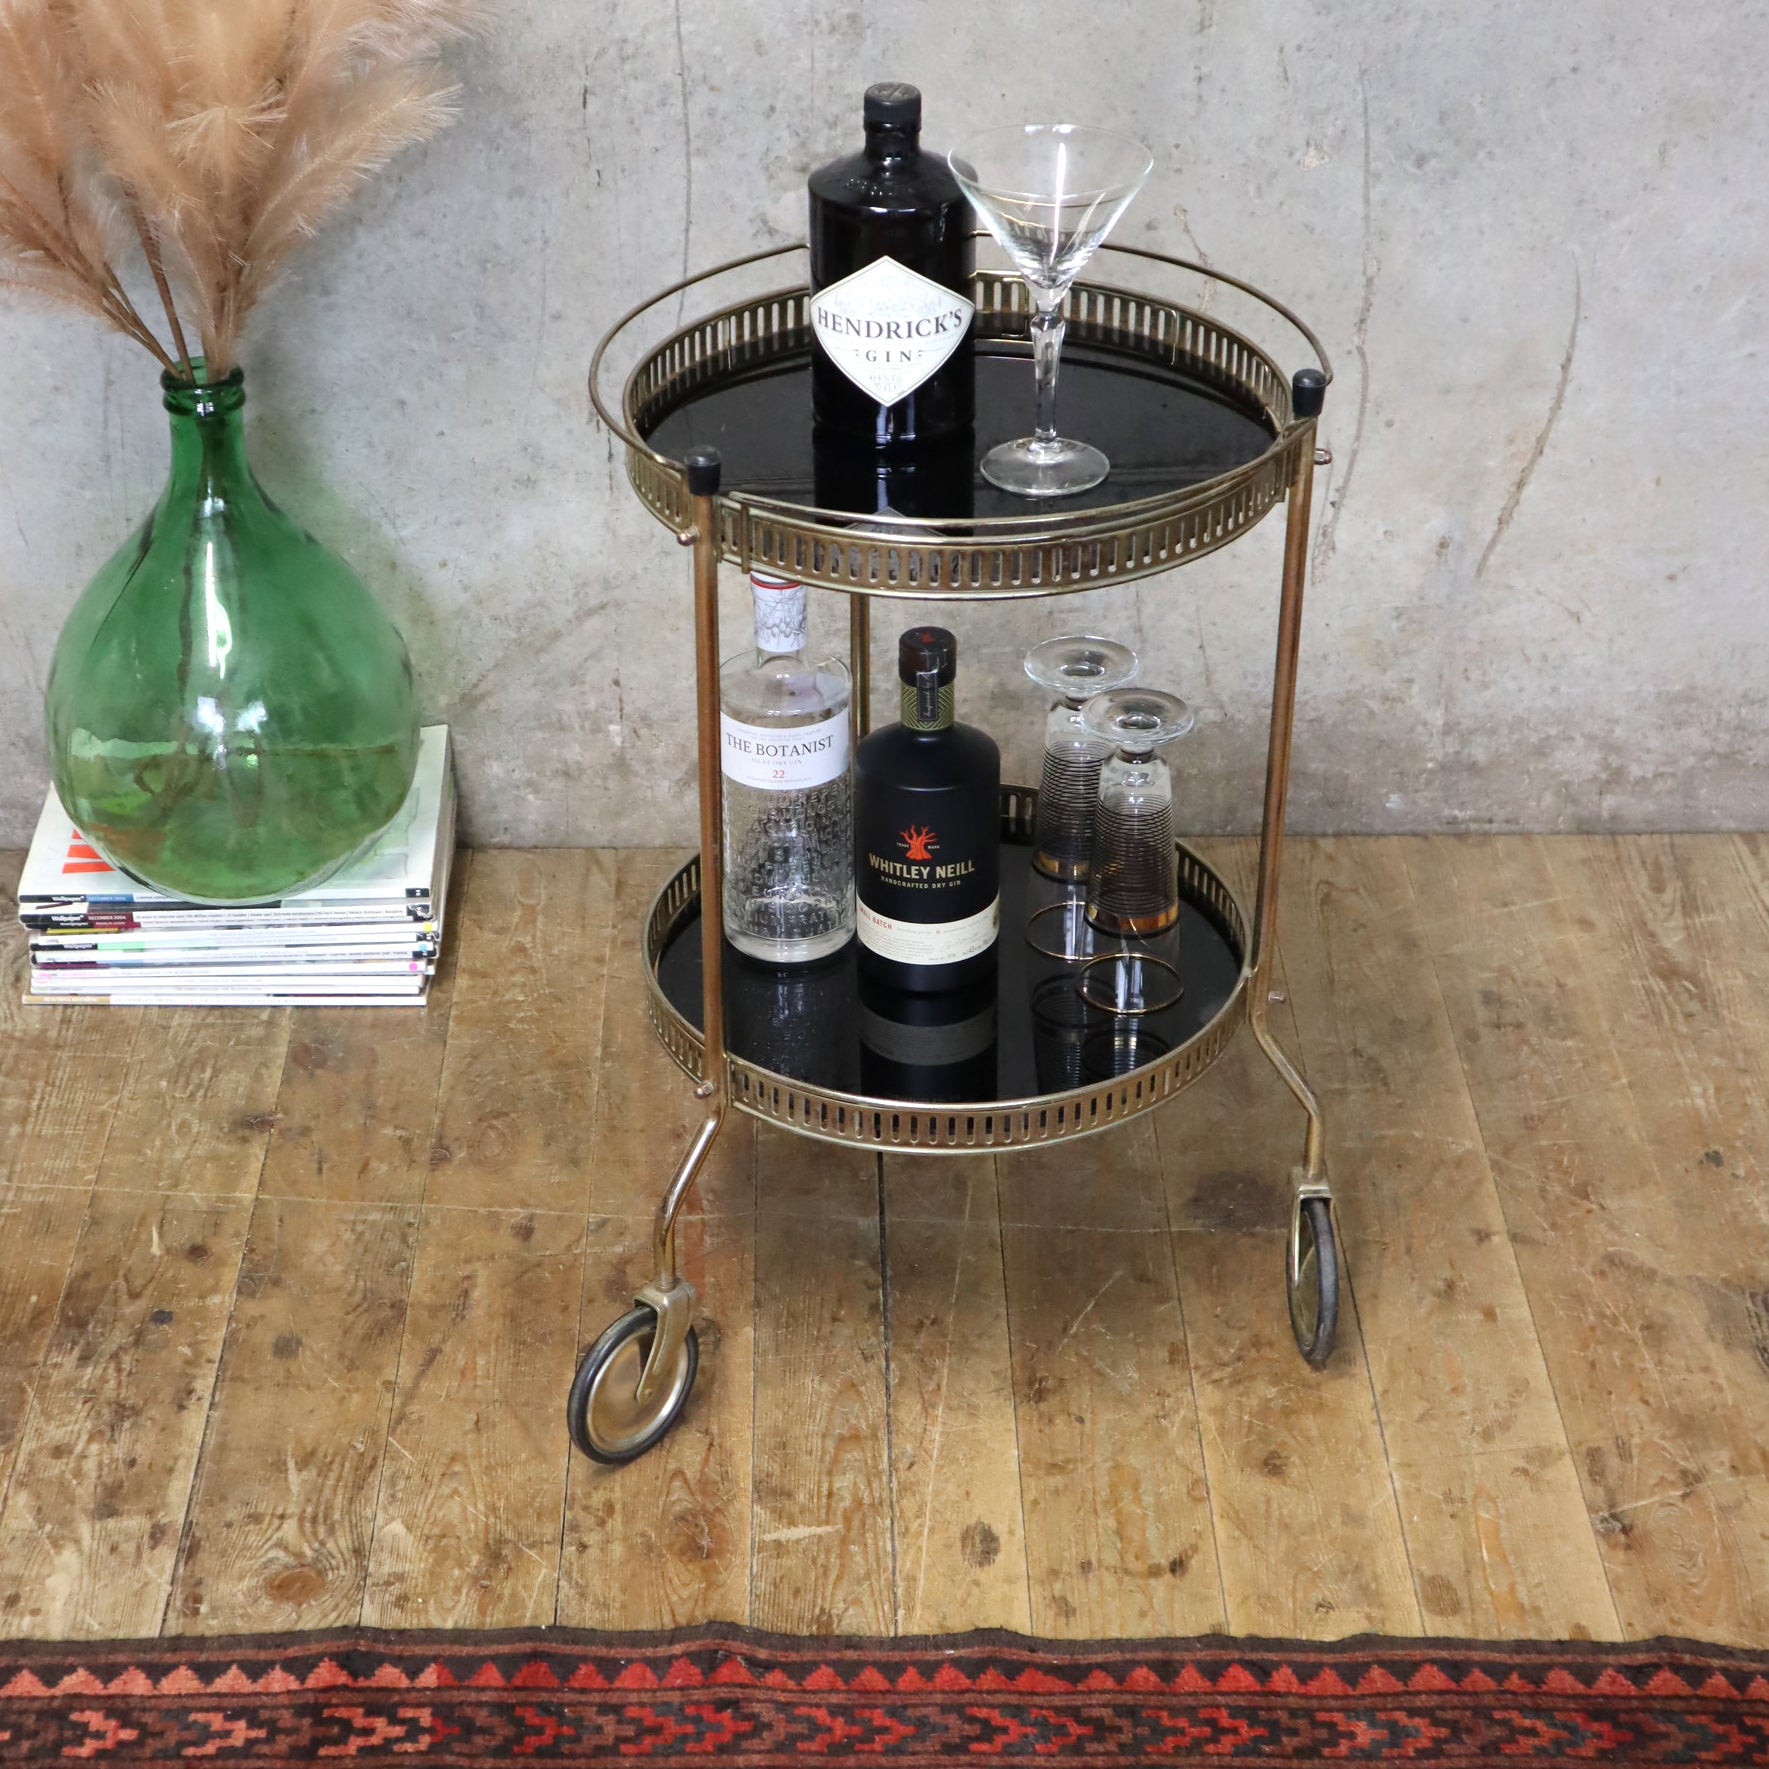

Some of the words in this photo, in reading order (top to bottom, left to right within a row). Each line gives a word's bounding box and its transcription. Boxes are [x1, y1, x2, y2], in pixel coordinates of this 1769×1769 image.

[817, 306, 963, 340] HENDRICK'S
[866, 350, 912, 363] GIN
[726, 732, 752, 753] THE
[756, 735, 834, 757] BOTANIST
[772, 769, 785, 779] 22
[868, 853, 930, 879] WHITLEY
[935, 860, 976, 879] NEILL
[880, 875, 929, 889] HANDCRAFTED
[949, 879, 961, 888] GIN
[872, 916, 892, 930] BATCH
